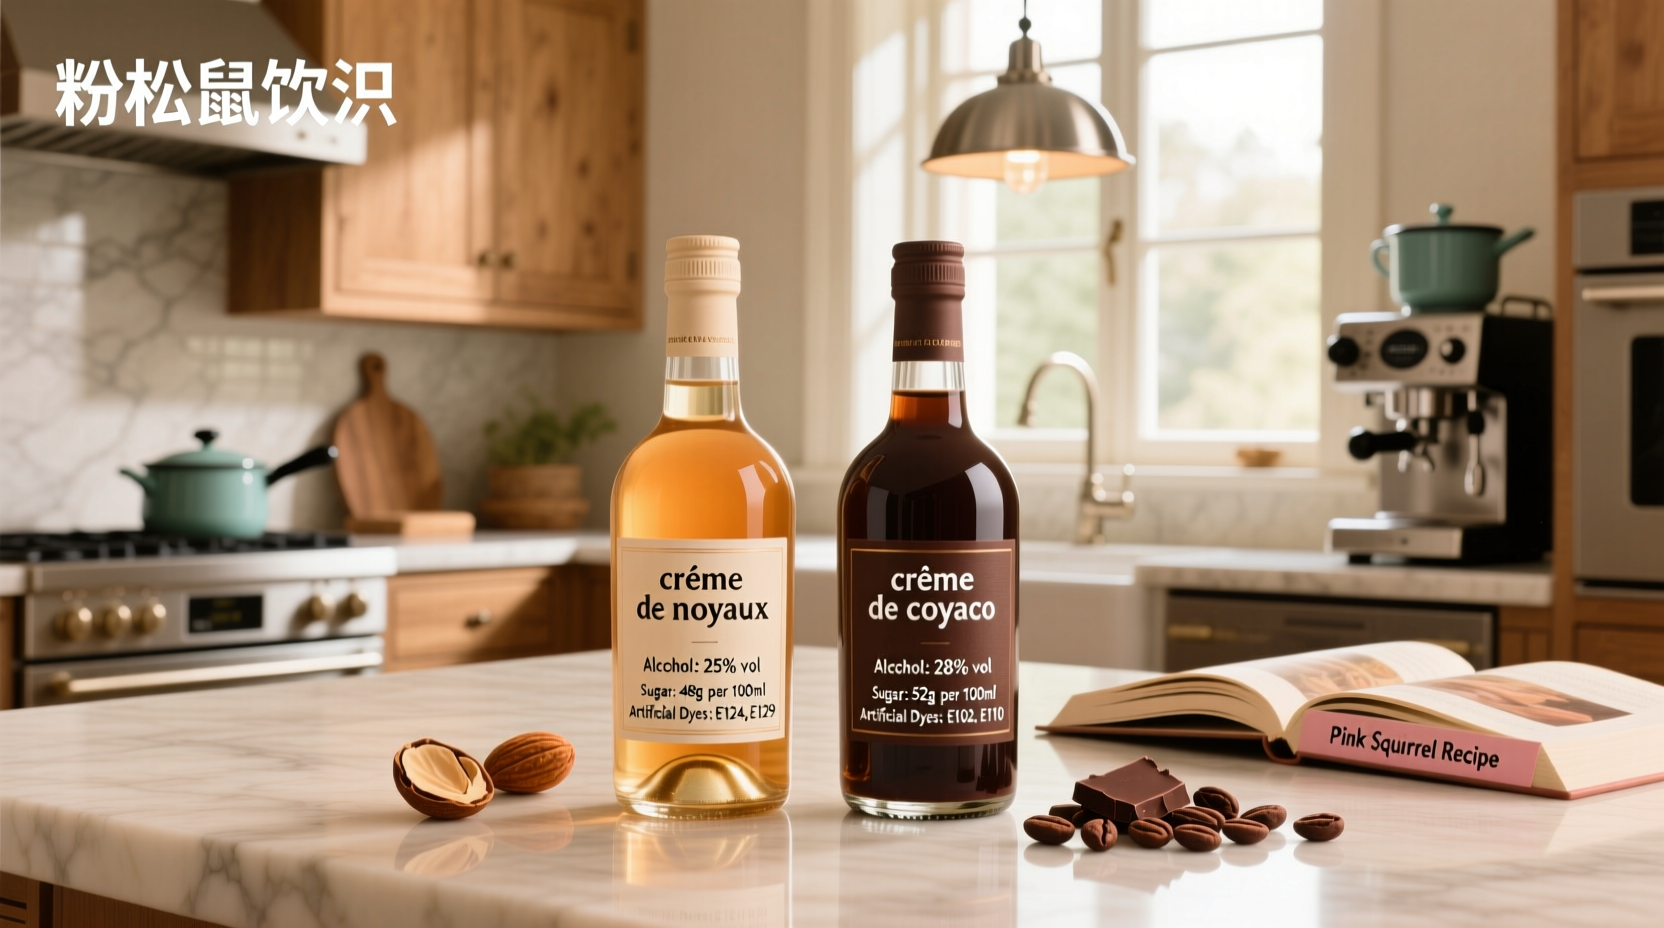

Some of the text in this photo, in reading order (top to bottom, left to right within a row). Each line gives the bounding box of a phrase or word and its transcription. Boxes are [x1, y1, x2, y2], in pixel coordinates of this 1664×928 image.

[636, 593, 769, 629] de noyaux
[868, 593, 996, 630] de coyaco
[643, 656, 761, 674] Alcohol: 25% vol
[934, 658, 969, 676] 28%
[972, 656, 992, 674] vol
[640, 682, 766, 703] Sugar: 48g per 100ml
[871, 684, 997, 706] Sugar: 52g per 100ml
[679, 706, 713, 725] Dyes:
[910, 709, 944, 727] Dyes:
[980, 706, 1005, 723] E110
[1329, 725, 1501, 771] Pink Squirrel Recipe
